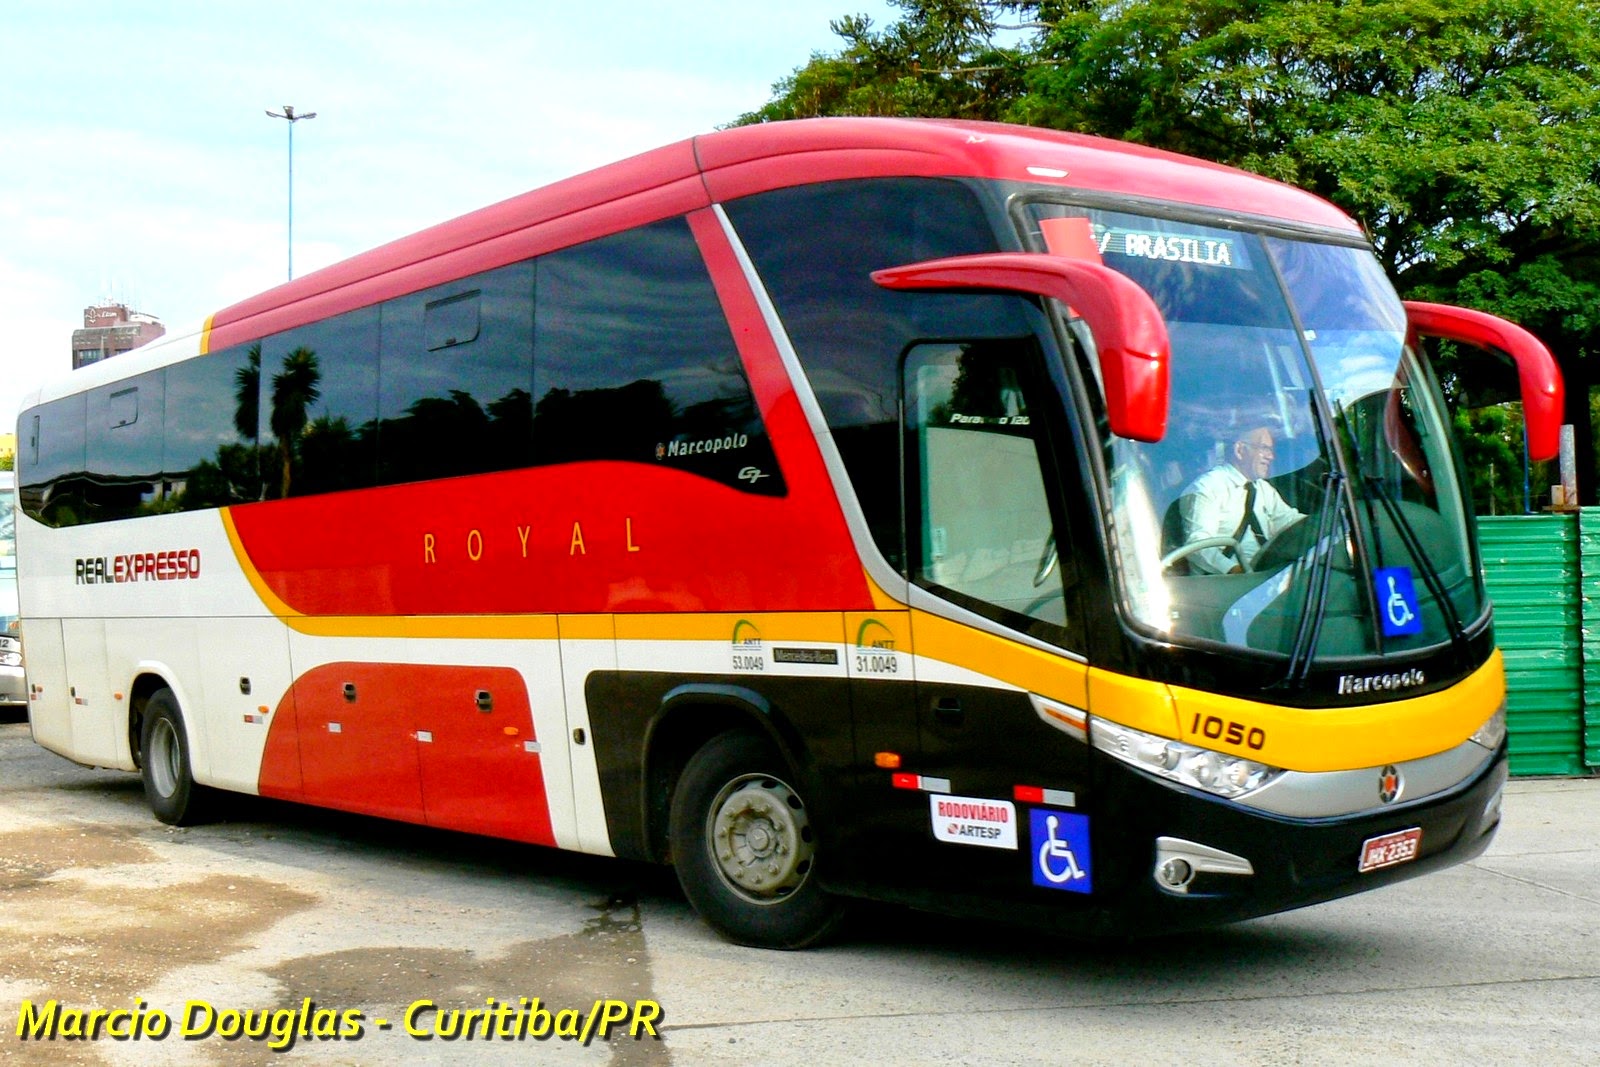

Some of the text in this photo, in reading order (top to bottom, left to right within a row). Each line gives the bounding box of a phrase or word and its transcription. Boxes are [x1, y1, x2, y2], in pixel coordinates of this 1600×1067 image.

[1125, 233, 1231, 266] BRASILIA
[668, 433, 747, 456] Marcopolo
[743, 637, 761, 646] ANTT
[872, 640, 895, 649] ANTT
[732, 655, 764, 671] 53.0049
[856, 655, 898, 673] 31.0049
[1337, 668, 1425, 695] Marcopolo
[1191, 712, 1266, 750] 1050
[938, 802, 1009, 823] RODOVIÁRIO
[958, 824, 1001, 840] ARTESP
